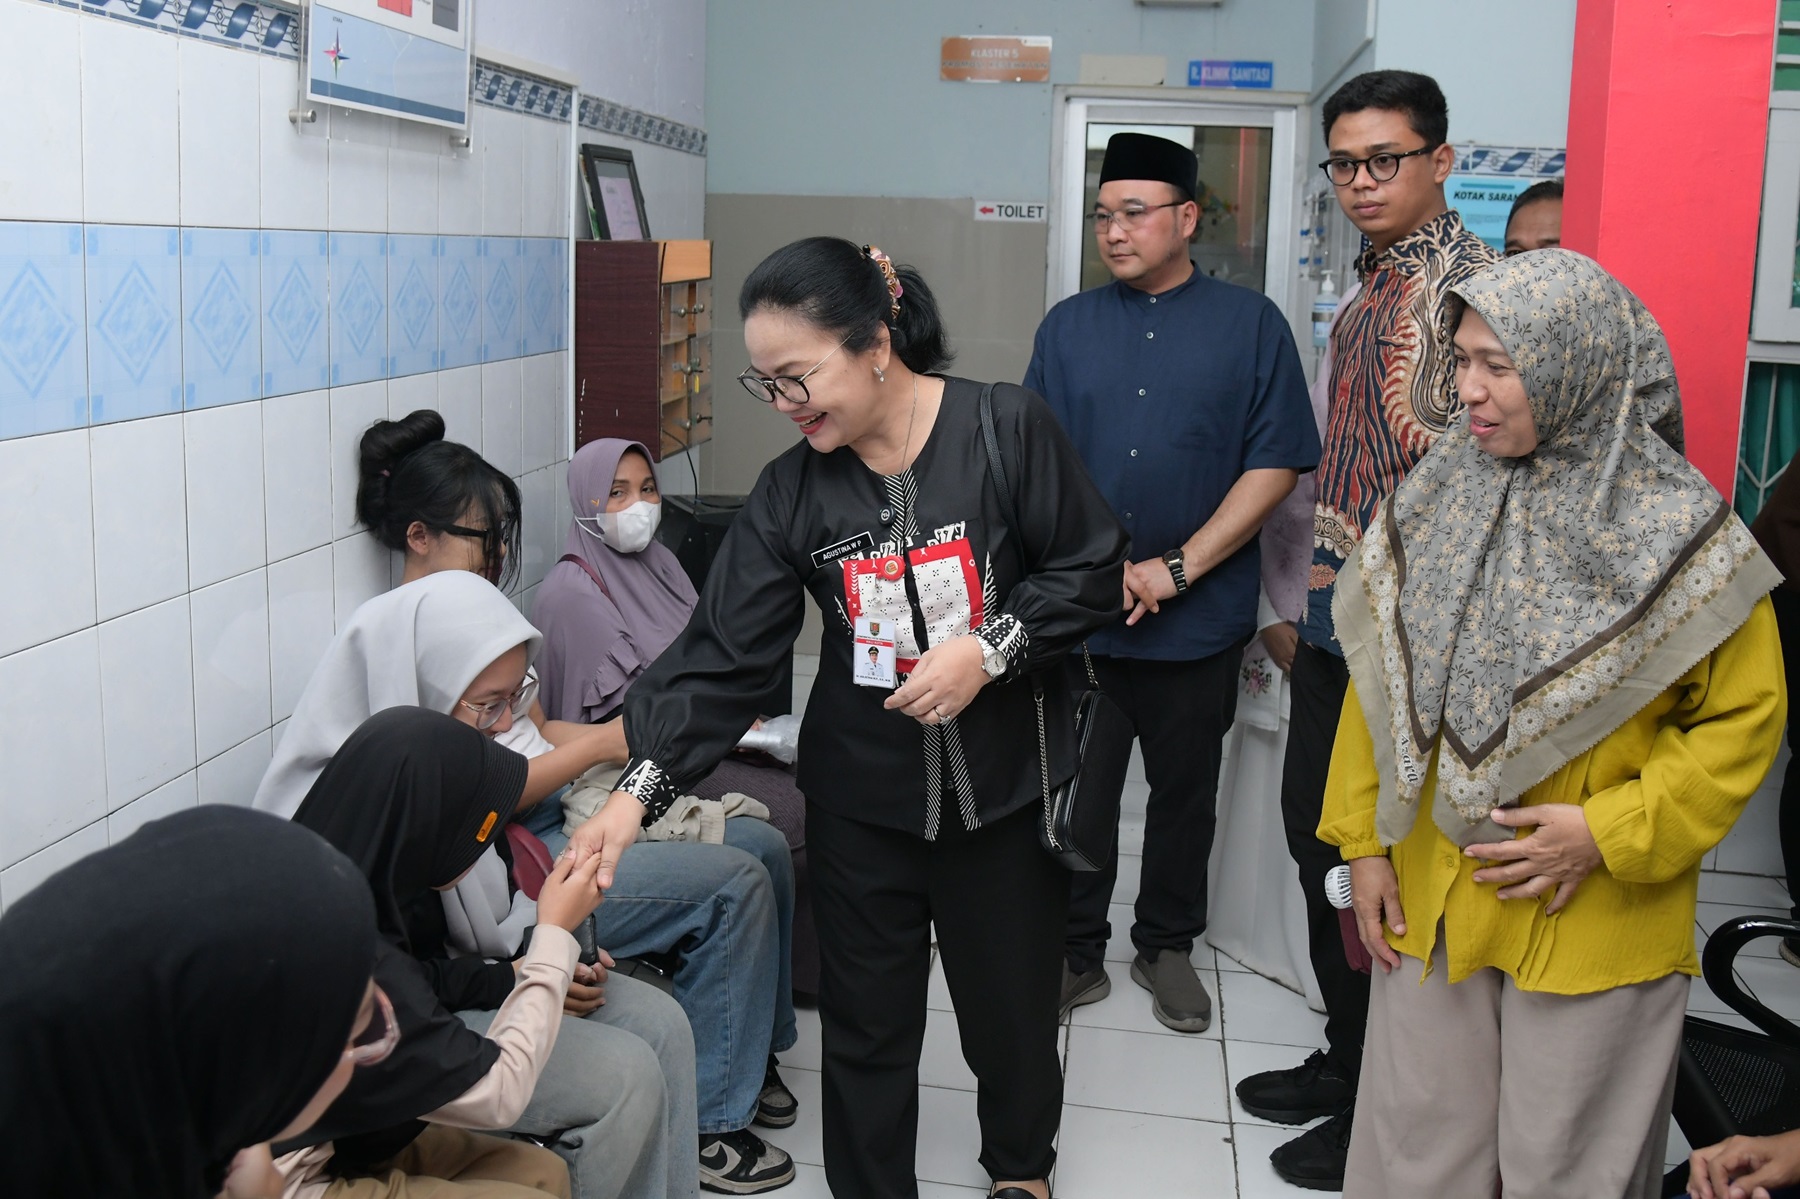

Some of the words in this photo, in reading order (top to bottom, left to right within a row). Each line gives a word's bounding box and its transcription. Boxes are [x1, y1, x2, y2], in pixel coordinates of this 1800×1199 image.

[970, 48, 1010, 58] KLASTER
[1012, 48, 1019, 59] 5
[1201, 66, 1230, 80] KLINIK
[1231, 67, 1271, 82] SANITASI
[1453, 190, 1486, 201] KOTAK
[996, 204, 1045, 219] TOILET
[822, 544, 851, 561] AGUSTINA
[850, 541, 858, 549] W
[1401, 733, 1419, 783] Azara
